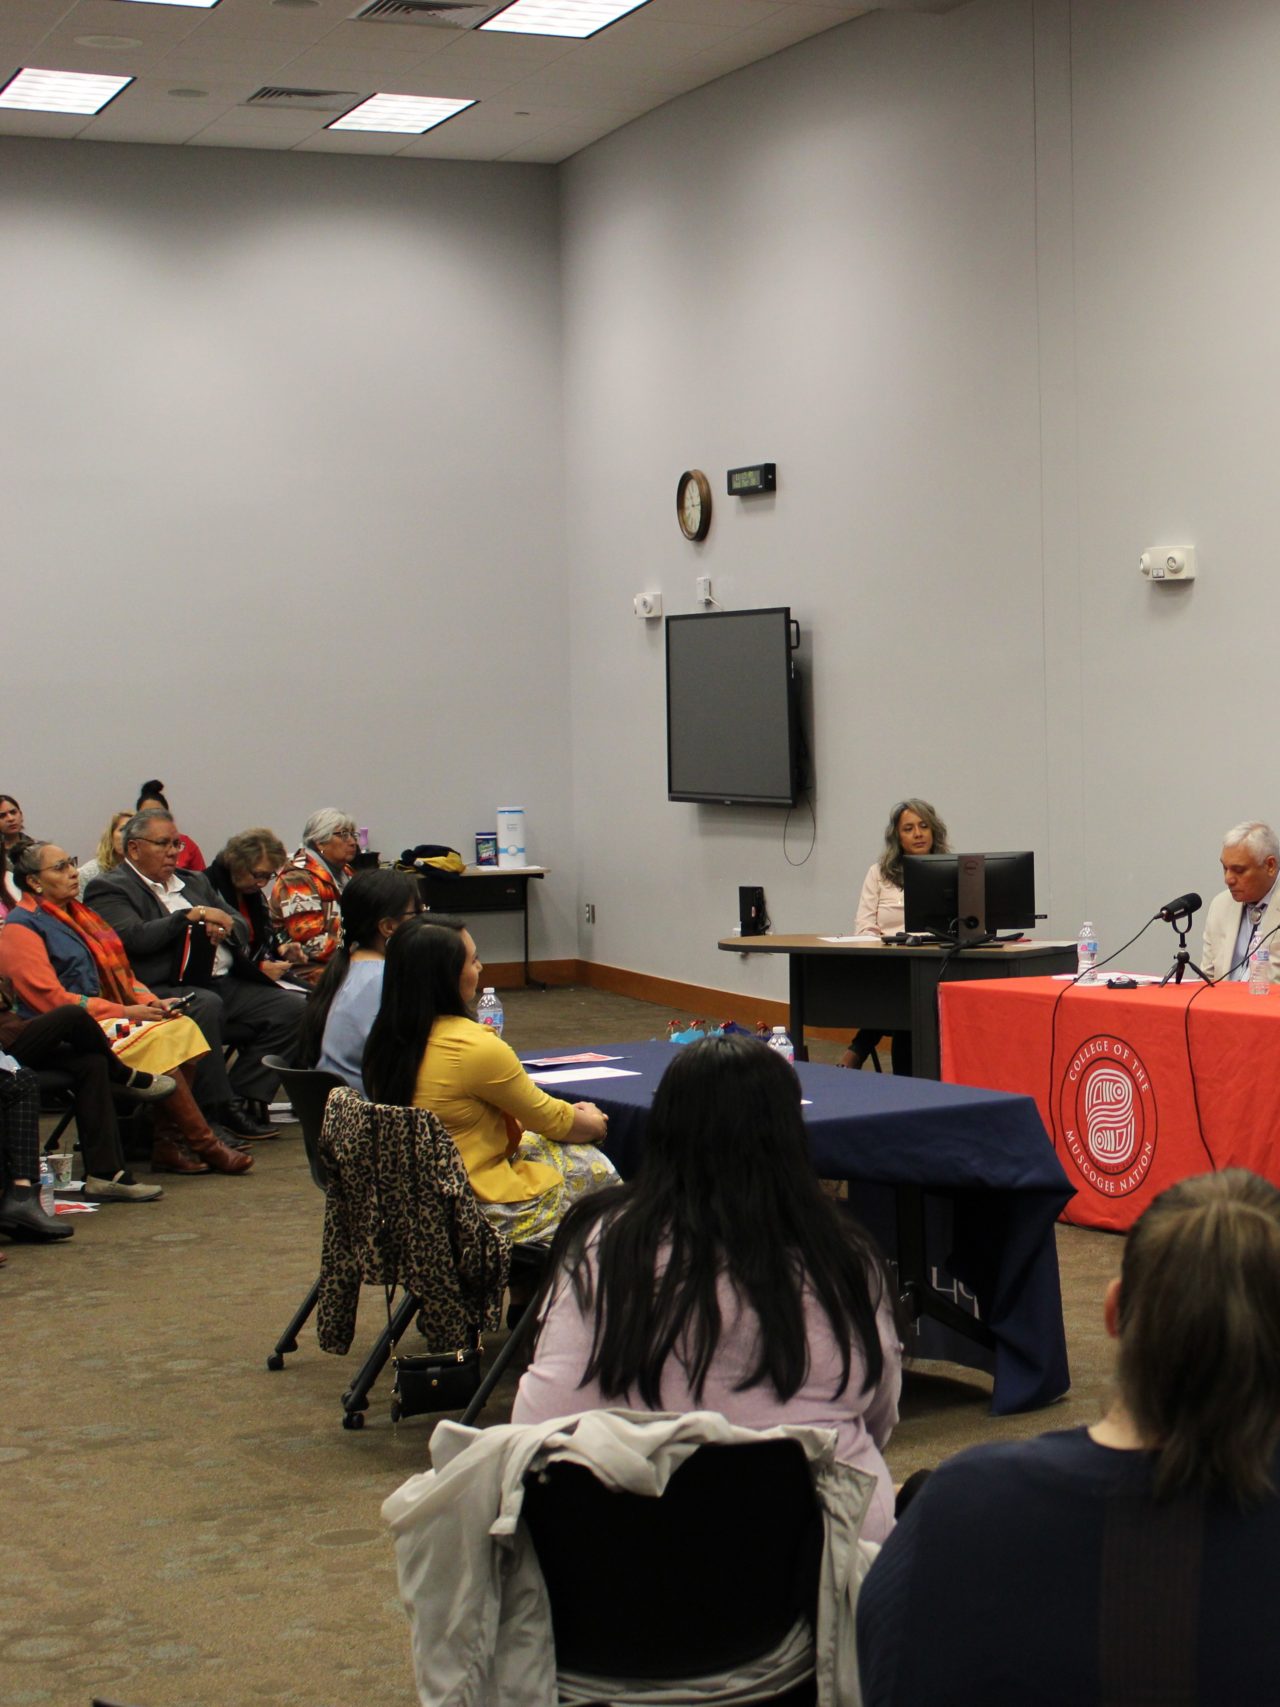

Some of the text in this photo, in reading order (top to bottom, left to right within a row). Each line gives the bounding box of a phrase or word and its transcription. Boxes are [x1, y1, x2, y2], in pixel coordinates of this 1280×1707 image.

[1069, 1040, 1149, 1092] COLLEGE OF THE
[1066, 1130, 1115, 1193] MUSCOGEE
[1120, 1142, 1152, 1191] NATION
